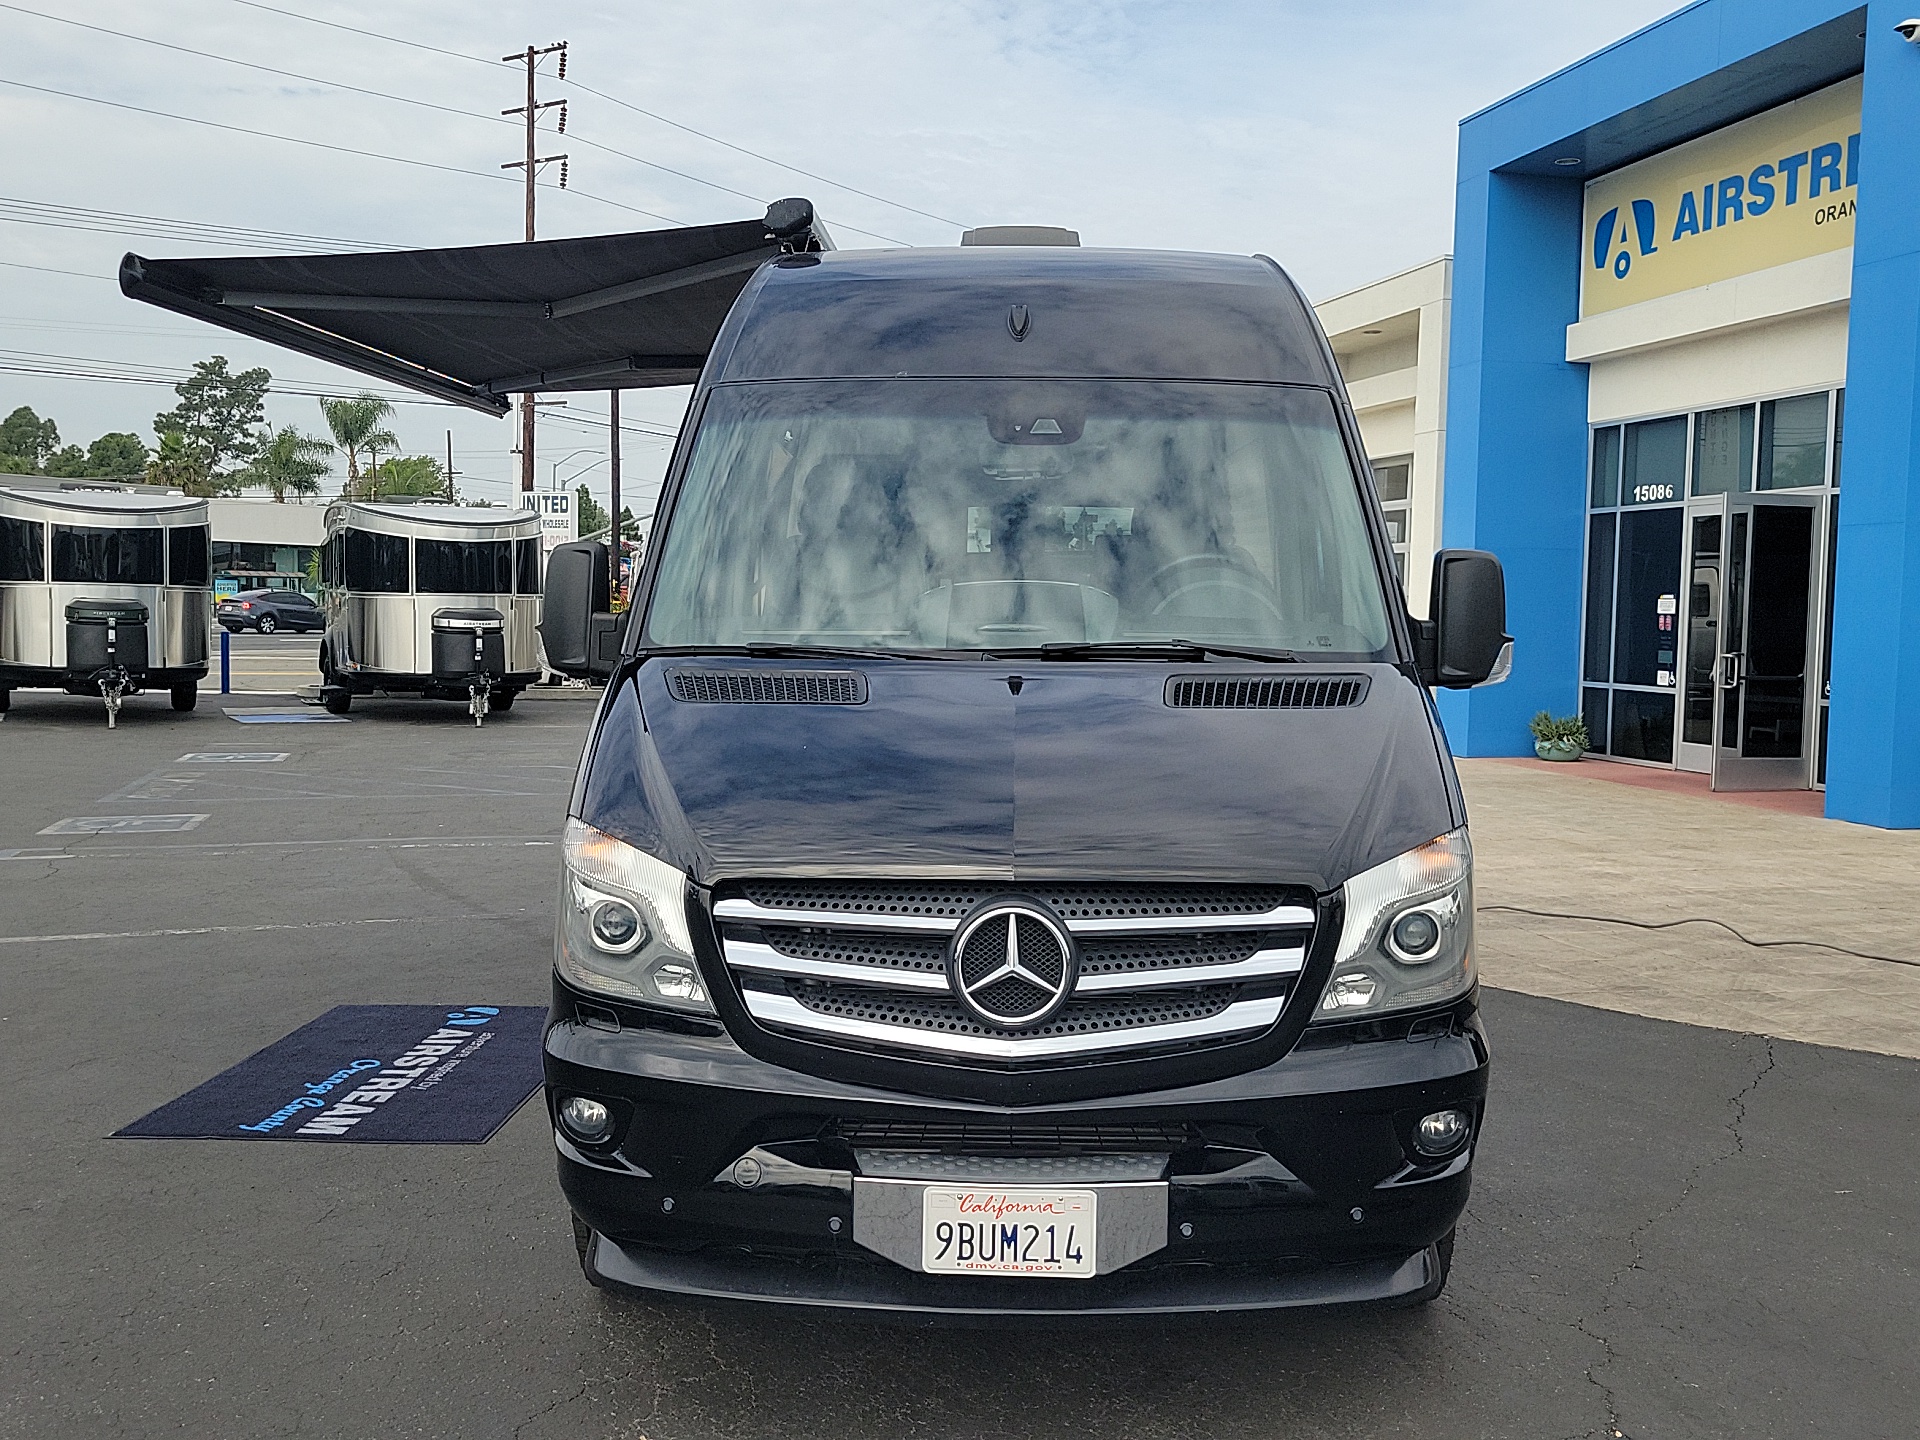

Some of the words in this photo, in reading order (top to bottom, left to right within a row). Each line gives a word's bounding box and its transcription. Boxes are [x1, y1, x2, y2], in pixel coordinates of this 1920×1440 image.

[1633, 484, 1674, 502] 15086
[295, 1028, 474, 1135] AIRSTREAM
[304, 1059, 381, 1095] Orange
[238, 1097, 326, 1132] County
[959, 1193, 1066, 1220] California
[934, 1221, 1083, 1265] 9BUM214
[965, 1261, 1053, 1272] dmv.ca.gov
